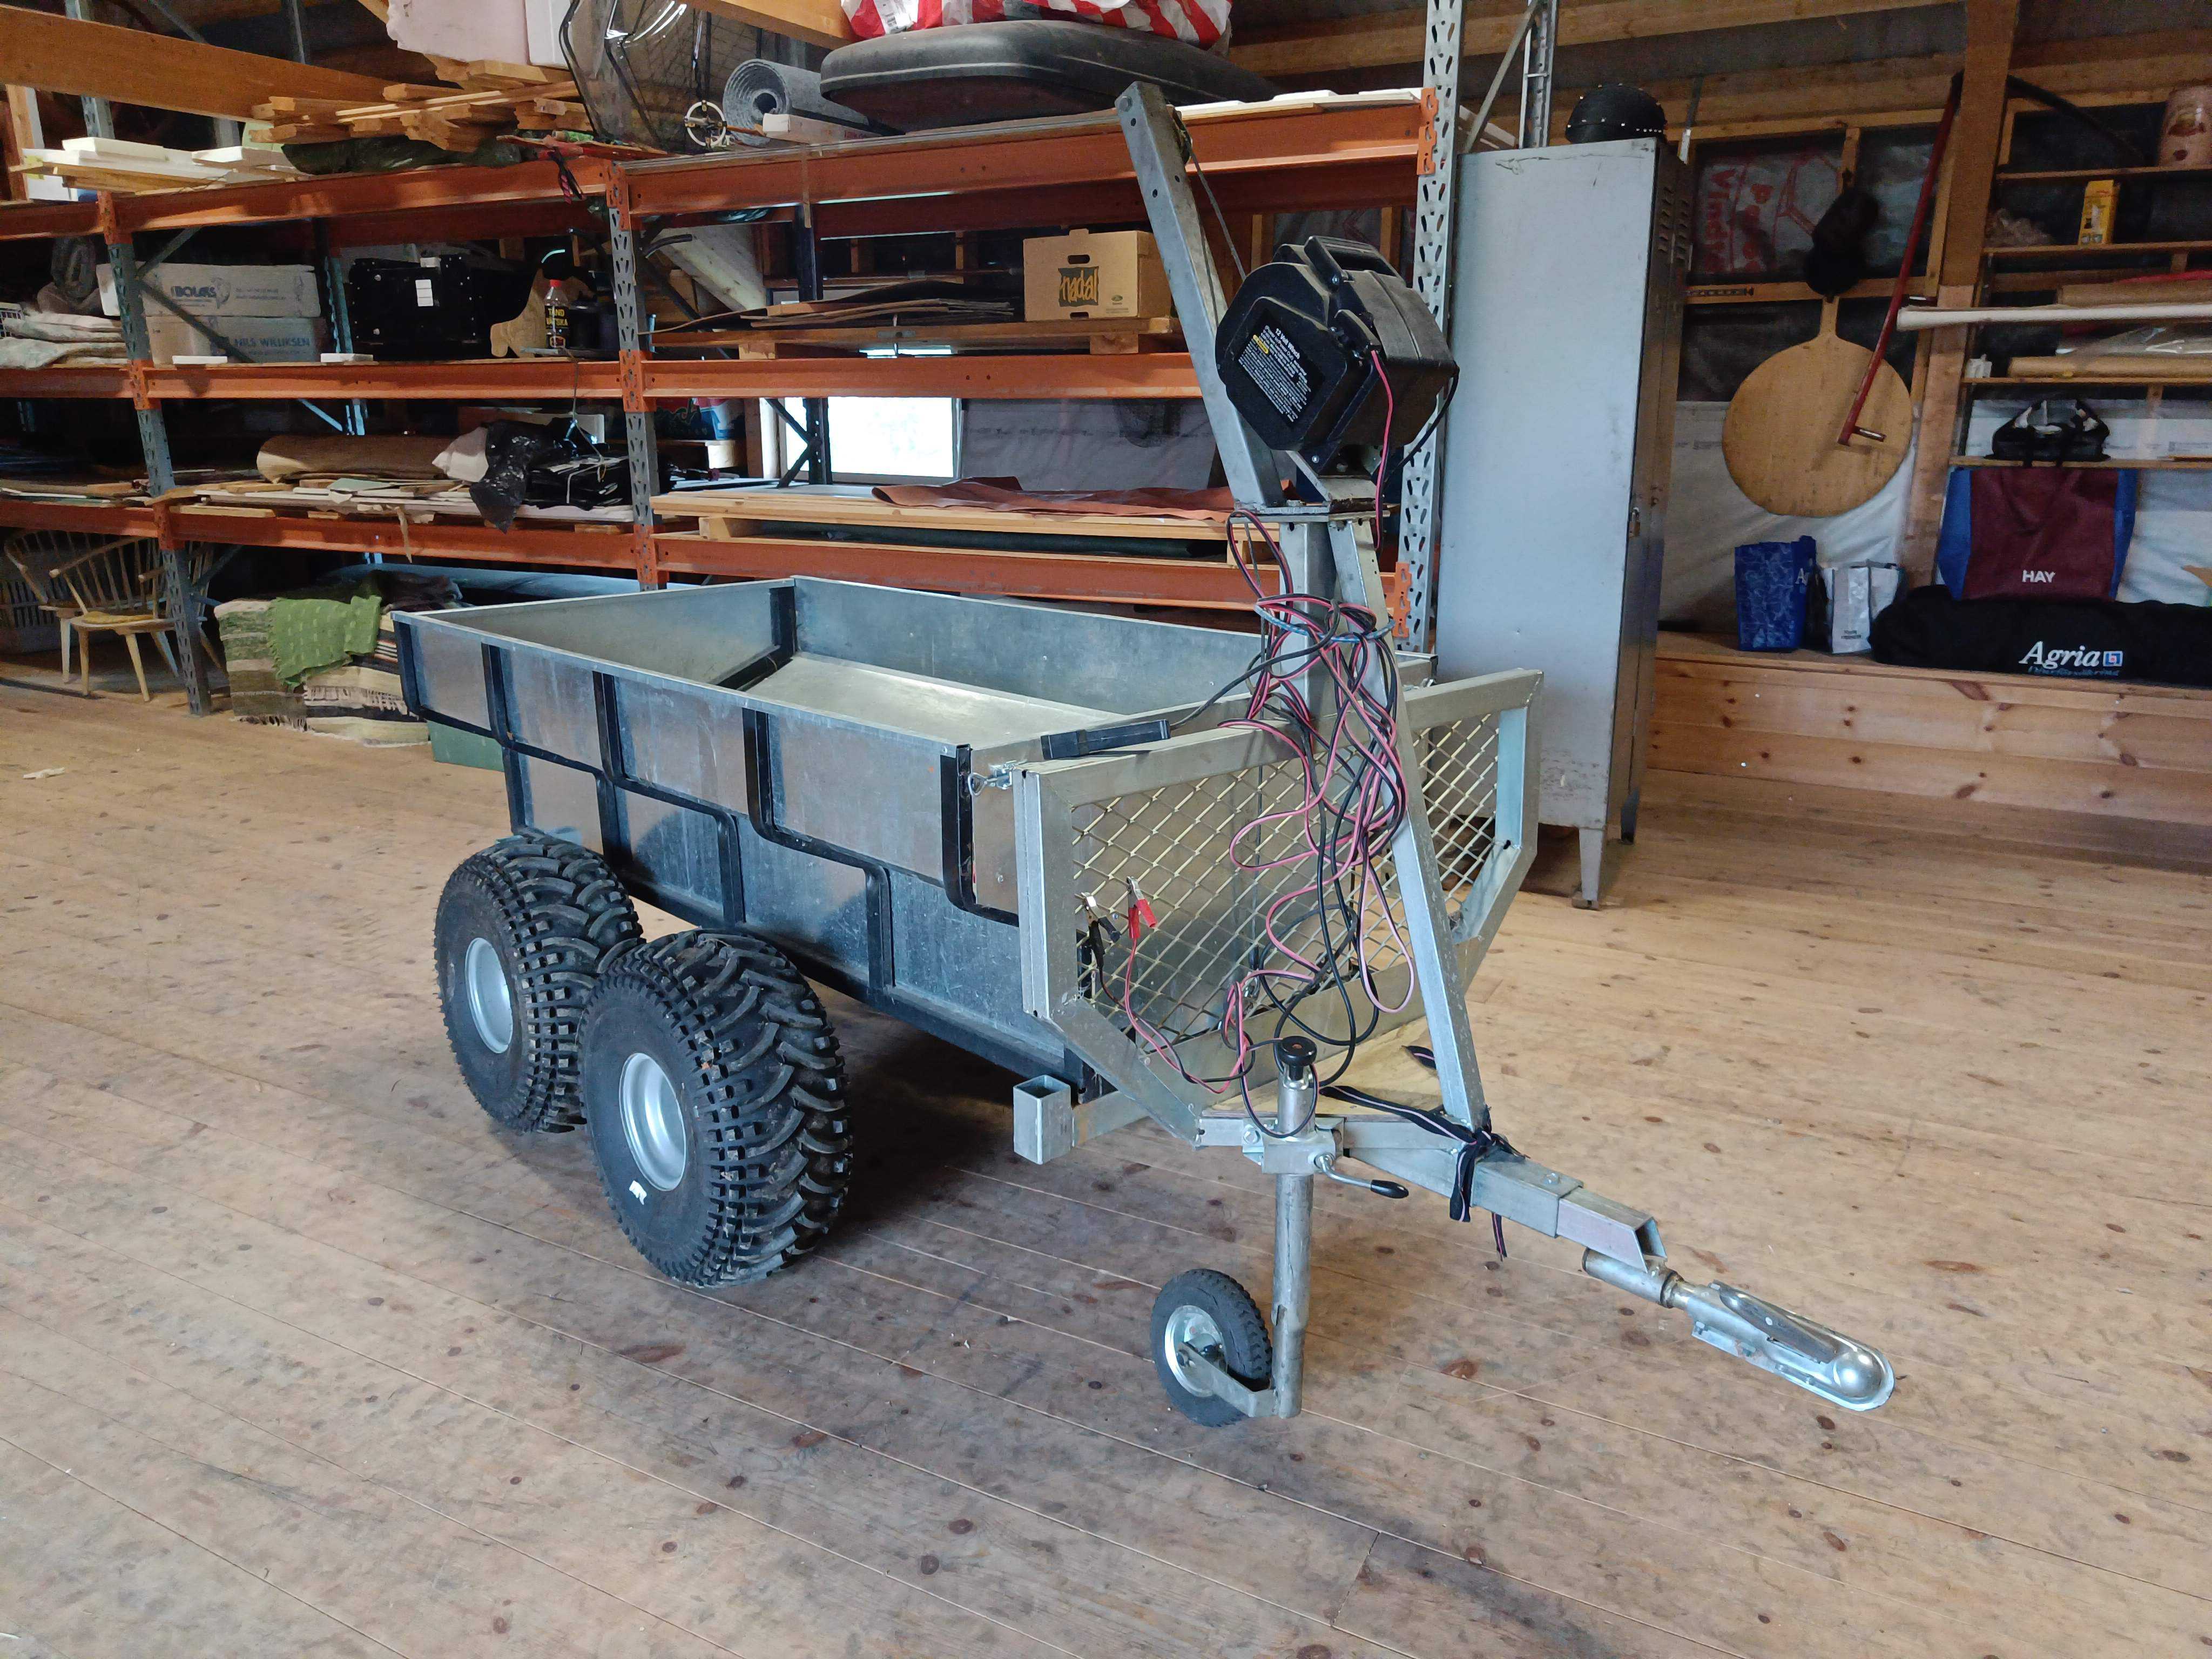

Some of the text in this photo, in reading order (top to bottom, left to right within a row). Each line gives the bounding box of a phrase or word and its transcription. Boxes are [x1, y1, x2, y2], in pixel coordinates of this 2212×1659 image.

[1276, 328, 1300, 359] 12 Volt Winch
[2022, 570, 2055, 582] HAY
[2018, 640, 2101, 670] Agria
